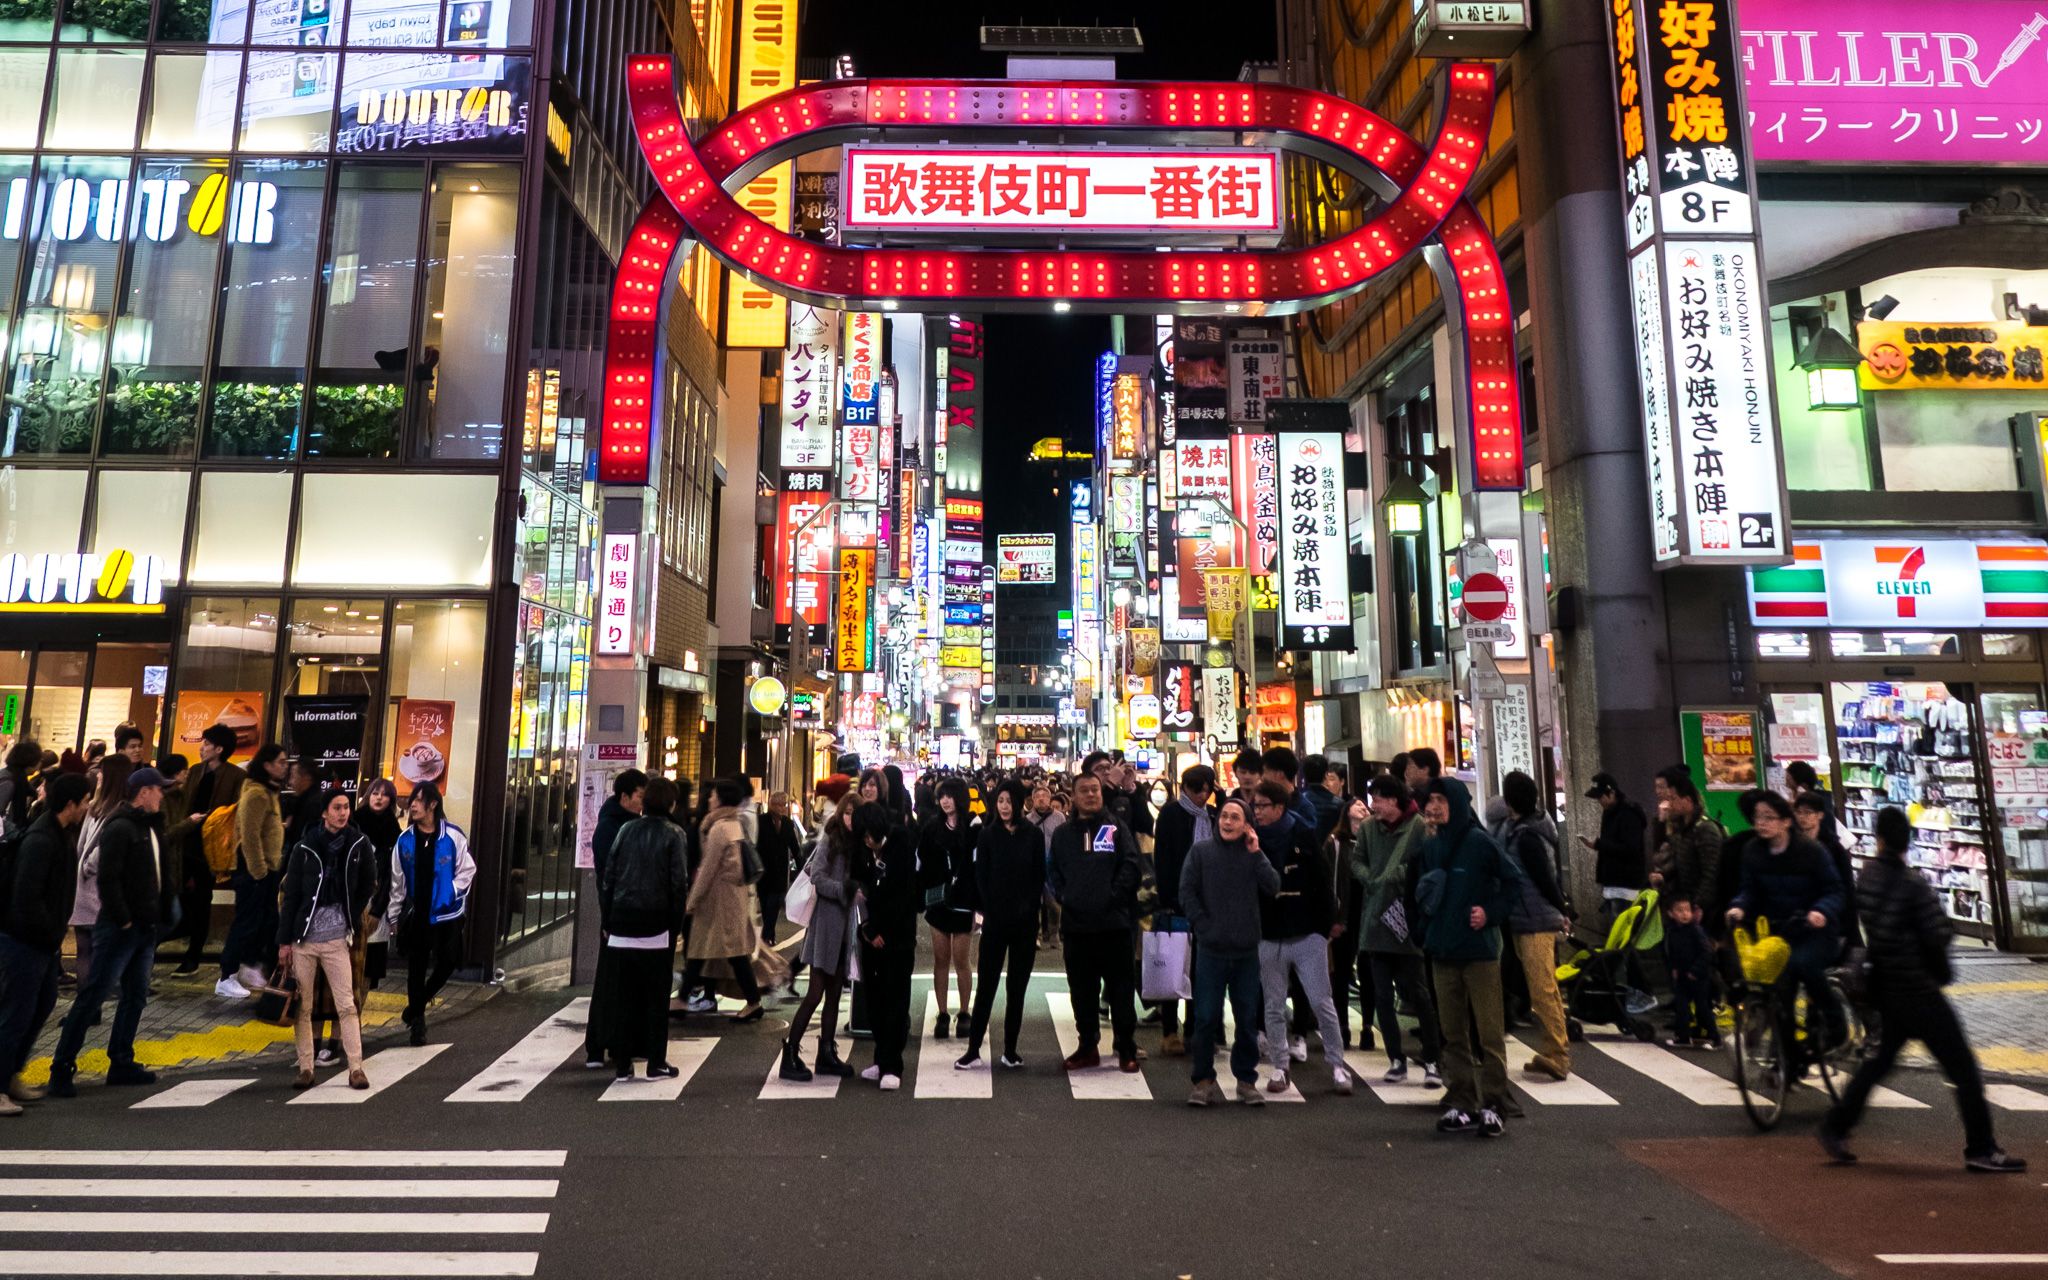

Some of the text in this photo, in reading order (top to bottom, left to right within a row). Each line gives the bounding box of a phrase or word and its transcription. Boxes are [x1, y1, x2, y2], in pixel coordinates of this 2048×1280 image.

[1450, 5, 1510, 22] 小松ビル
[1659, 0, 1728, 142] 好み焼
[356, 86, 511, 127] DOUTOR
[1665, 145, 1739, 182] 本陣
[863, 162, 1261, 218] 歌舞伎町一番街
[1681, 191, 1730, 223] 8F
[851, 313, 872, 400] まぐろ商店
[1731, 254, 1762, 444] OKONOMIYAKI HONJIN
[791, 343, 815, 432] バンタイ
[1242, 355, 1261, 420] 東南荘
[1680, 275, 1728, 516] お好み焼き本陣
[846, 407, 876, 420] B1F
[796, 453, 816, 463] 3F
[788, 473, 824, 490] 焼肉
[1253, 437, 1276, 571] 焼鳥釜めし
[1290, 464, 1323, 613] お好み焼本陣
[1741, 517, 1773, 543] 2F
[607, 542, 629, 643] 劇場通り
[1877, 580, 1932, 595] ELEVEN
[1302, 626, 1331, 644] 2F
[1466, 627, 1509, 639] 自転車を除く
[294, 710, 357, 722] information
[408, 724, 434, 736] コーヒー
[409, 712, 444, 725] キャラメル
[1704, 736, 1753, 755] 1本無料
[1989, 742, 2028, 760] たばこ
